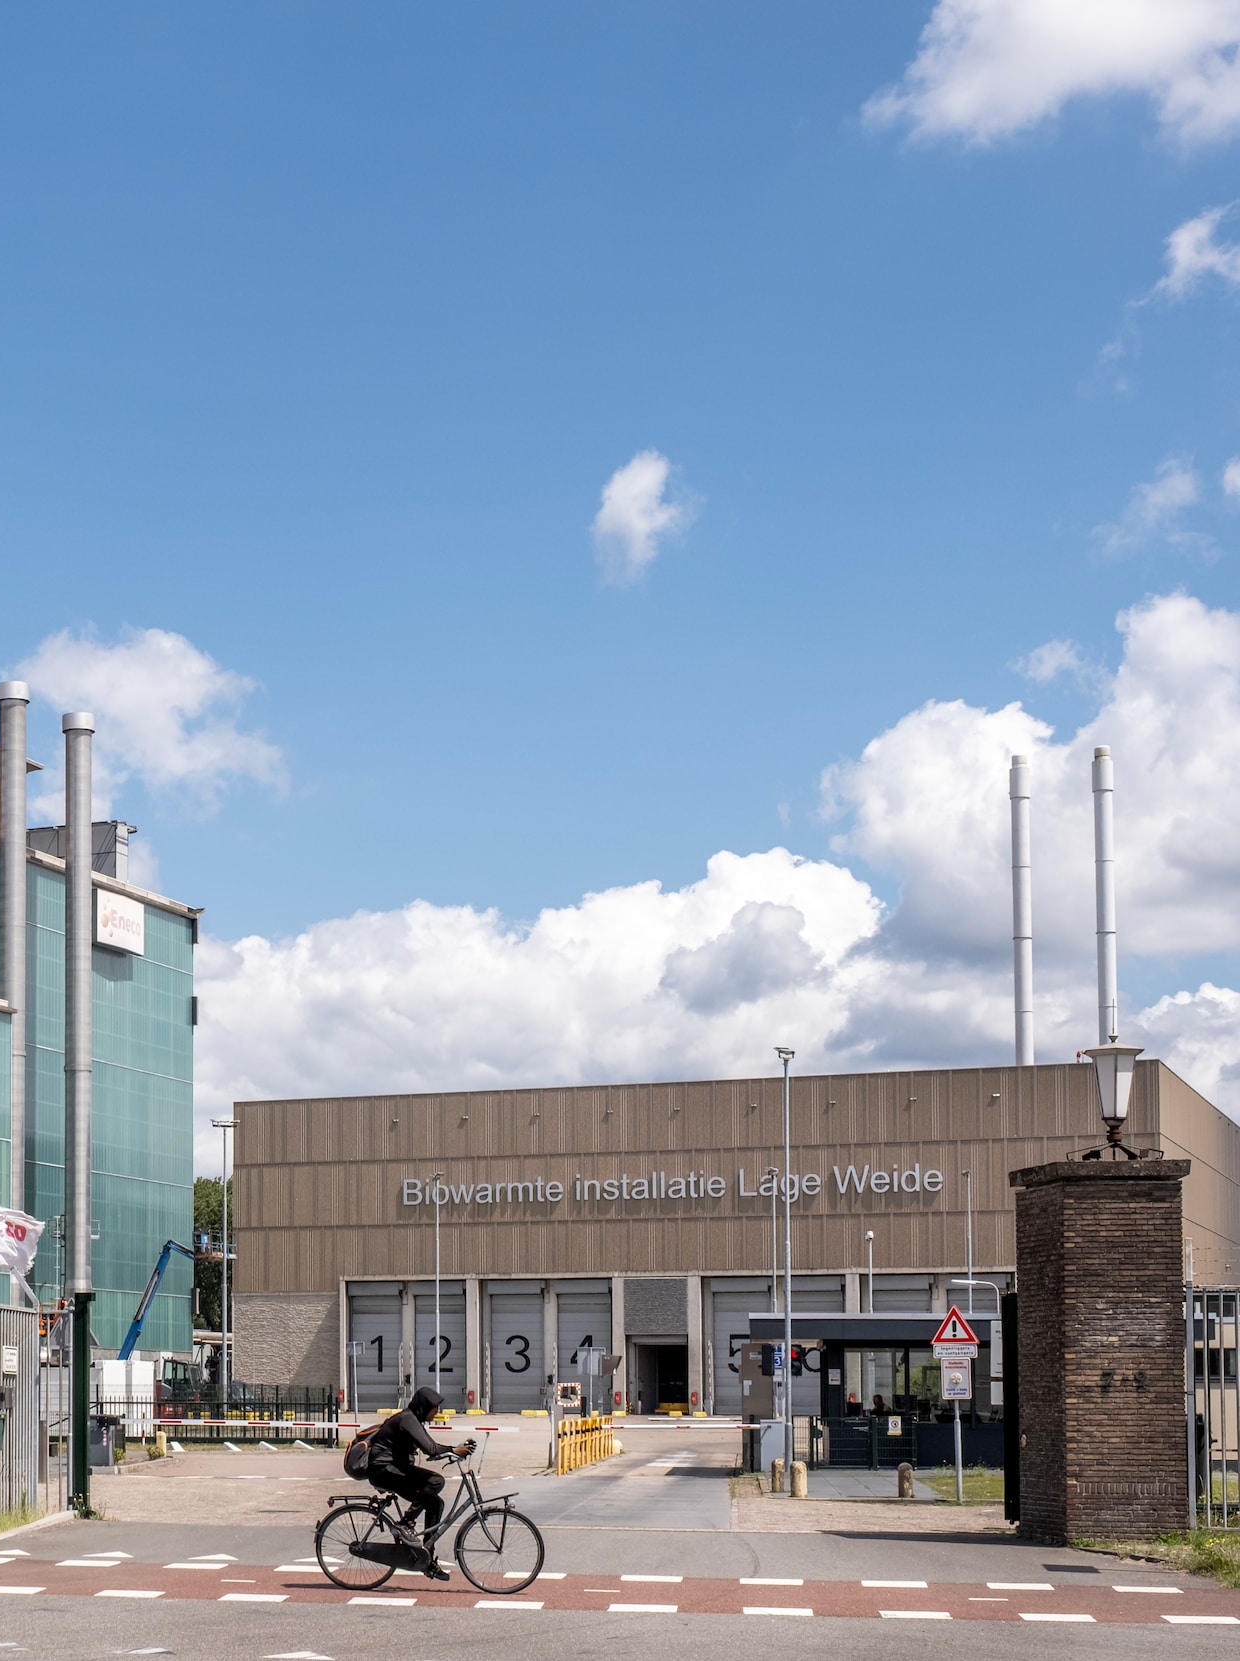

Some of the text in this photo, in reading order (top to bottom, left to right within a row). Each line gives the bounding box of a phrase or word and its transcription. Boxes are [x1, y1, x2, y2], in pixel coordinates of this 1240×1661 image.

[110, 909, 141, 937] Eneco
[402, 1163, 944, 1206] Biowarmte installatie Lage Weide
[370, 1335, 383, 1373] 1
[428, 1335, 454, 1373] 2
[505, 1334, 531, 1373] 3
